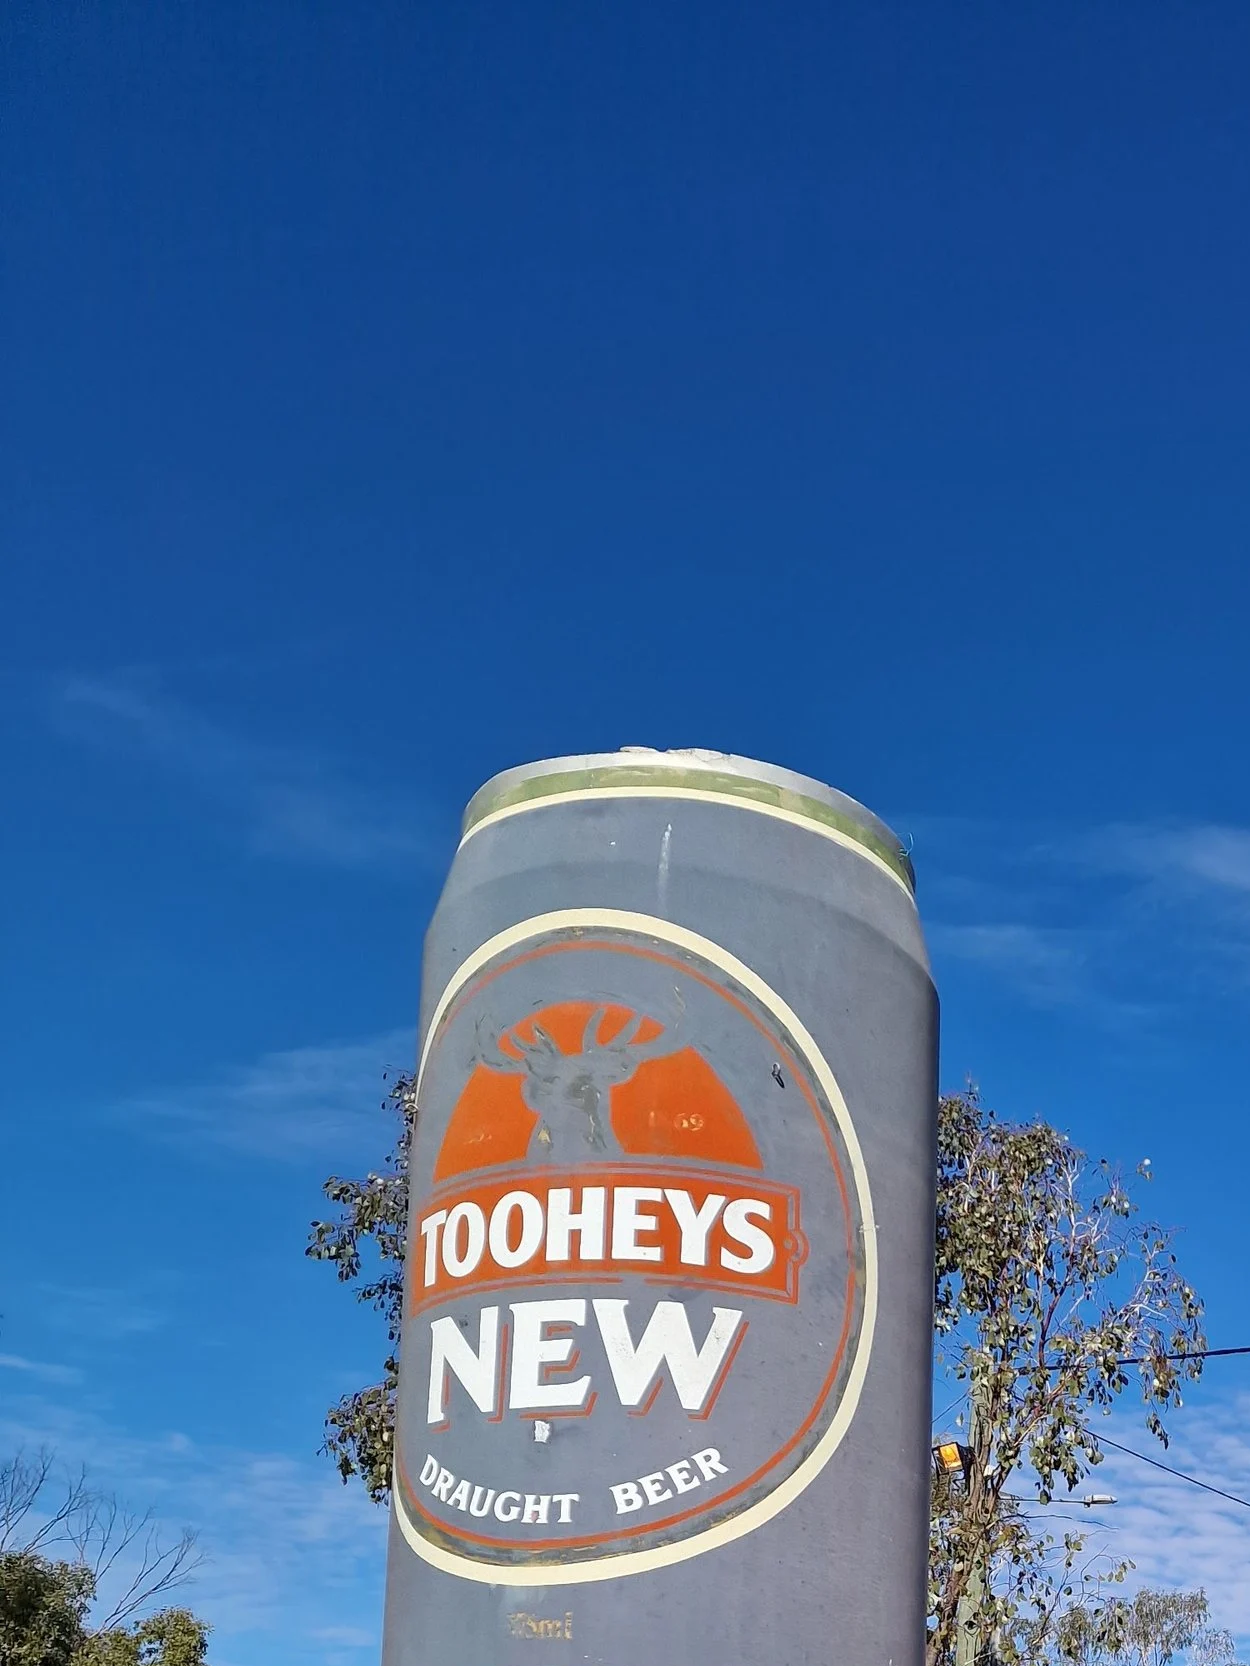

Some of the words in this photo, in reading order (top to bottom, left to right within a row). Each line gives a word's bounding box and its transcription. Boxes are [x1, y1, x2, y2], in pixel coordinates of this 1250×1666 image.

[420, 1186, 776, 1287] TOOHEYS
[427, 1299, 744, 1426] NEW
[419, 1454, 579, 1524] DRAUGHT
[609, 1447, 729, 1515] BEER
